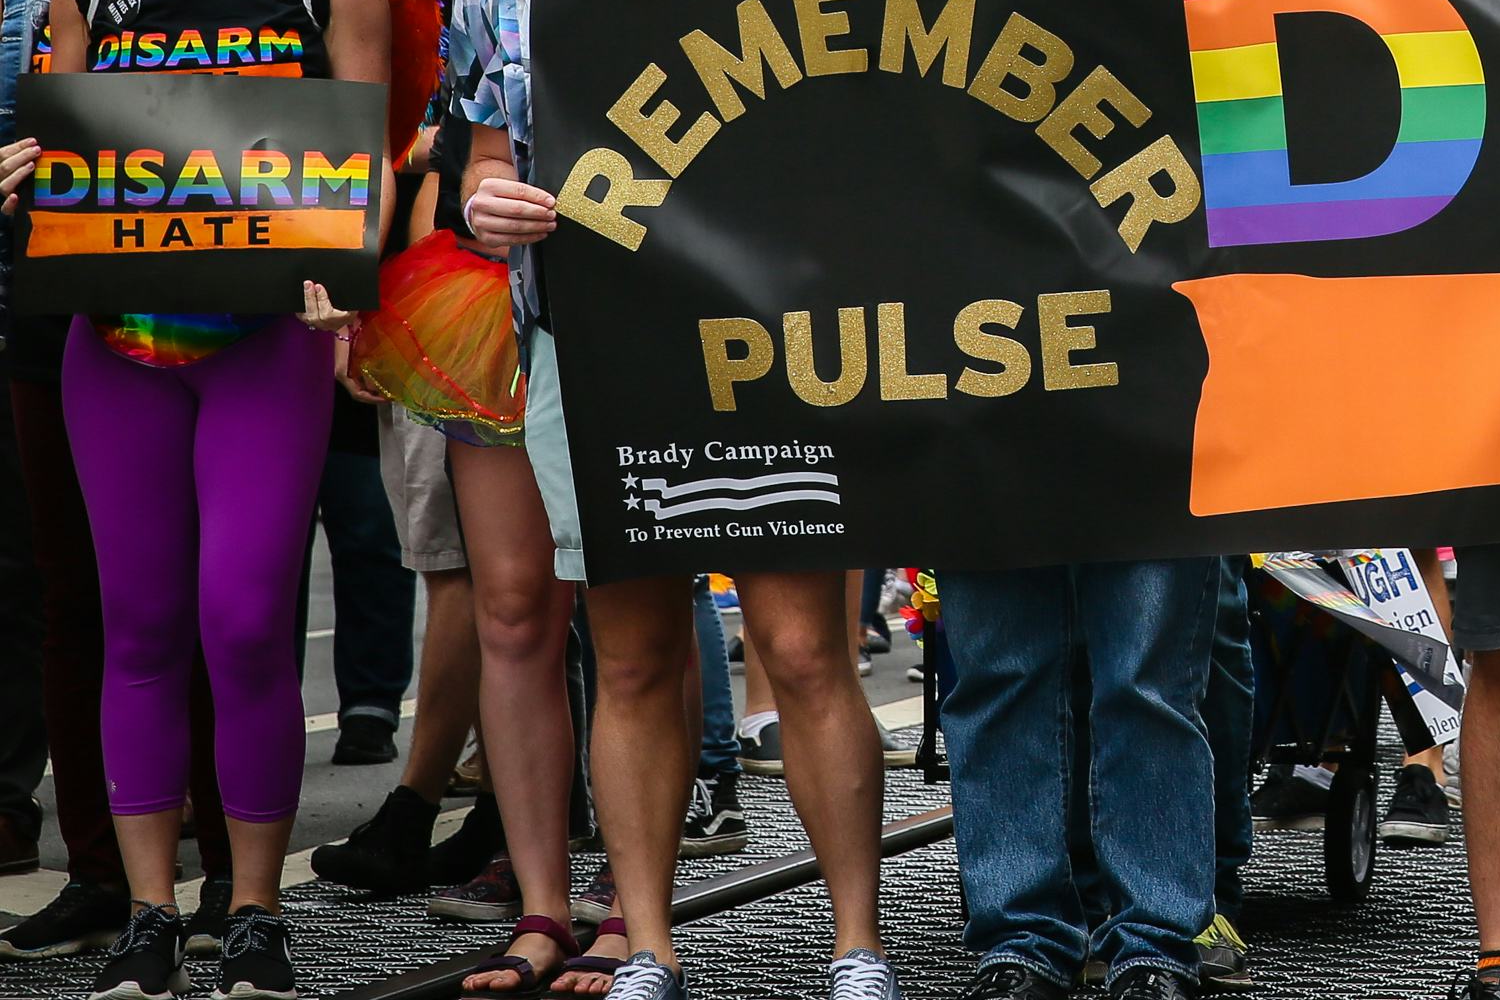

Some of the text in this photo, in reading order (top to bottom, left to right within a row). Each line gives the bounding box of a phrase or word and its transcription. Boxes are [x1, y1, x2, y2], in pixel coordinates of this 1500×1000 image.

[92, 25, 304, 71] DISARM
[34, 149, 372, 206] DISARM
[113, 216, 271, 249] HATE
[699, 289, 1119, 411] PULSE
[616, 440, 835, 469] Brady Campaign
[625, 520, 845, 543] To Prevent Gun Violence
[1429, 714, 1461, 738] olen
